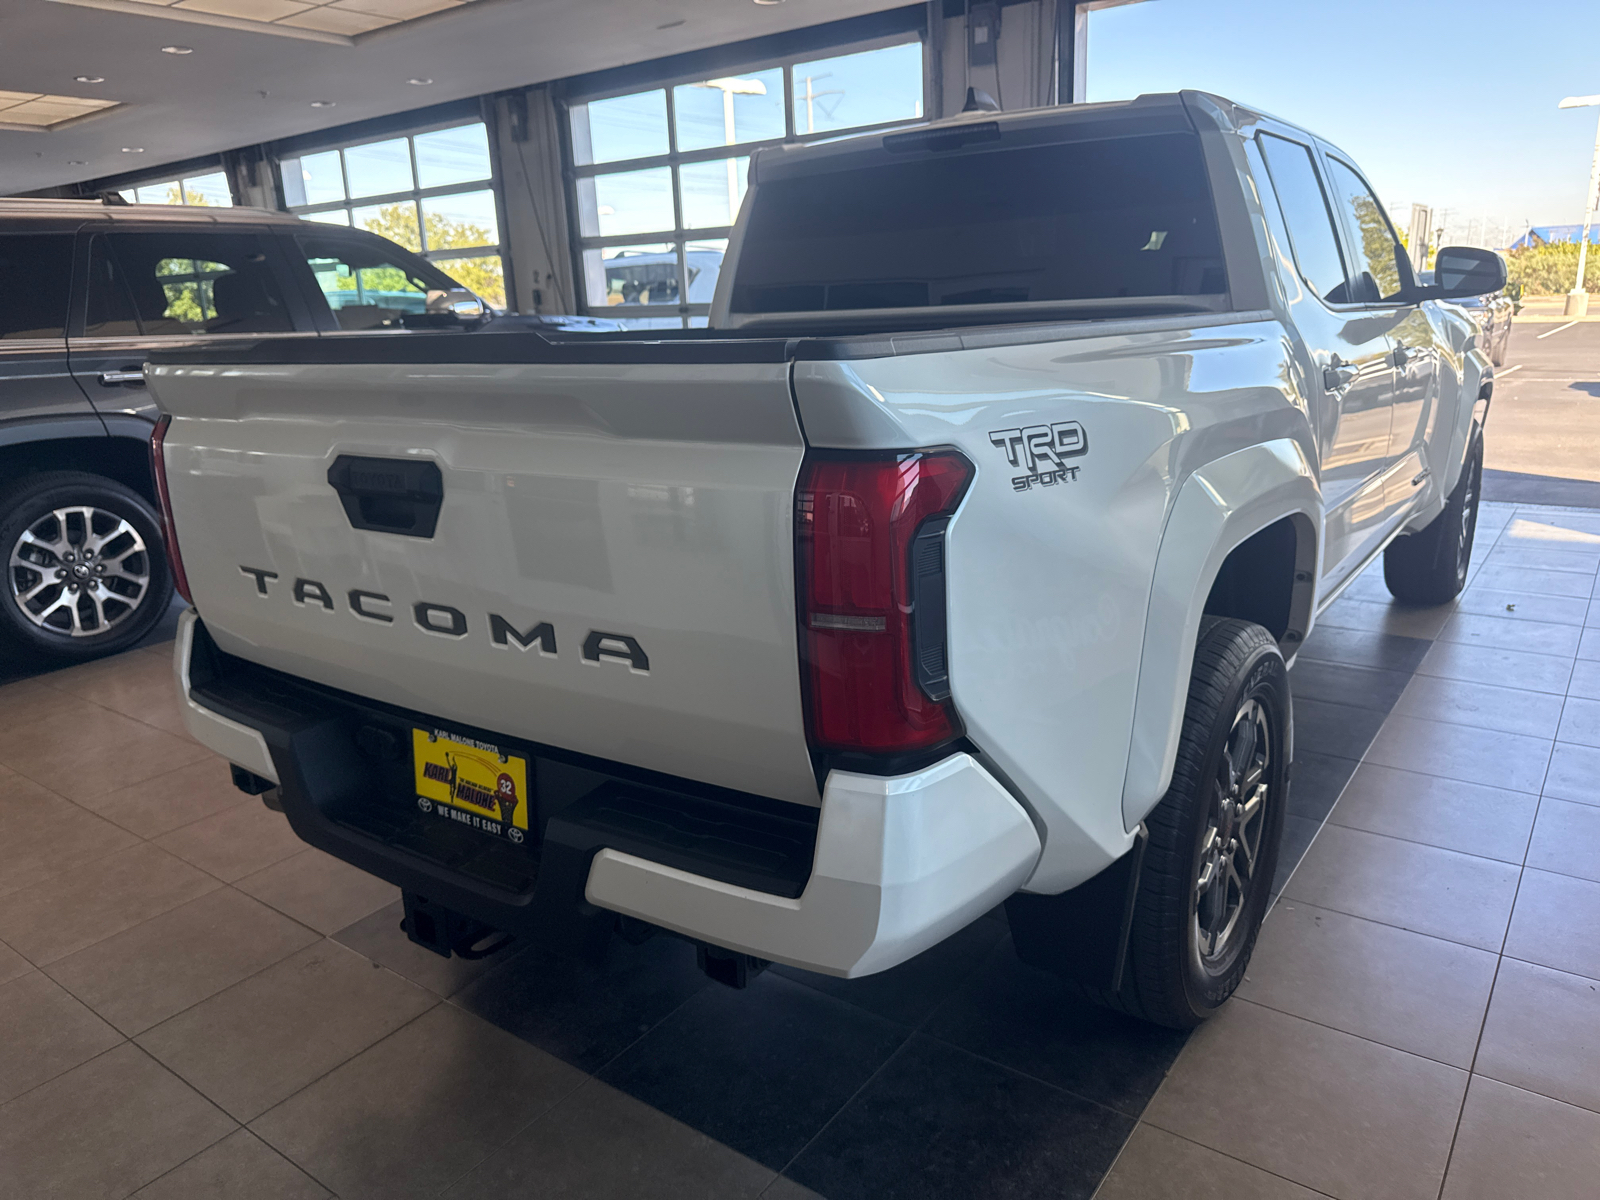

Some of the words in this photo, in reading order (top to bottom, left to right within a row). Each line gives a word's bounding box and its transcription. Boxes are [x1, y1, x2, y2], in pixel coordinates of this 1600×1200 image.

[988, 420, 1089, 475] TRD
[352, 471, 402, 488] TOYOTA
[1011, 466, 1081, 492] SPORT
[238, 564, 650, 676] TACOMA
[434, 728, 449, 740] KARL
[450, 733, 475, 748] MALONE
[475, 740, 499, 754] TOYOTA
[423, 761, 450, 784] KARL
[456, 782, 496, 812] MALONE
[500, 779, 512, 795] 32
[437, 804, 449, 818] WE
[450, 809, 471, 825] MAKE
[472, 816, 480, 828] IT
[482, 819, 502, 835] EASY
